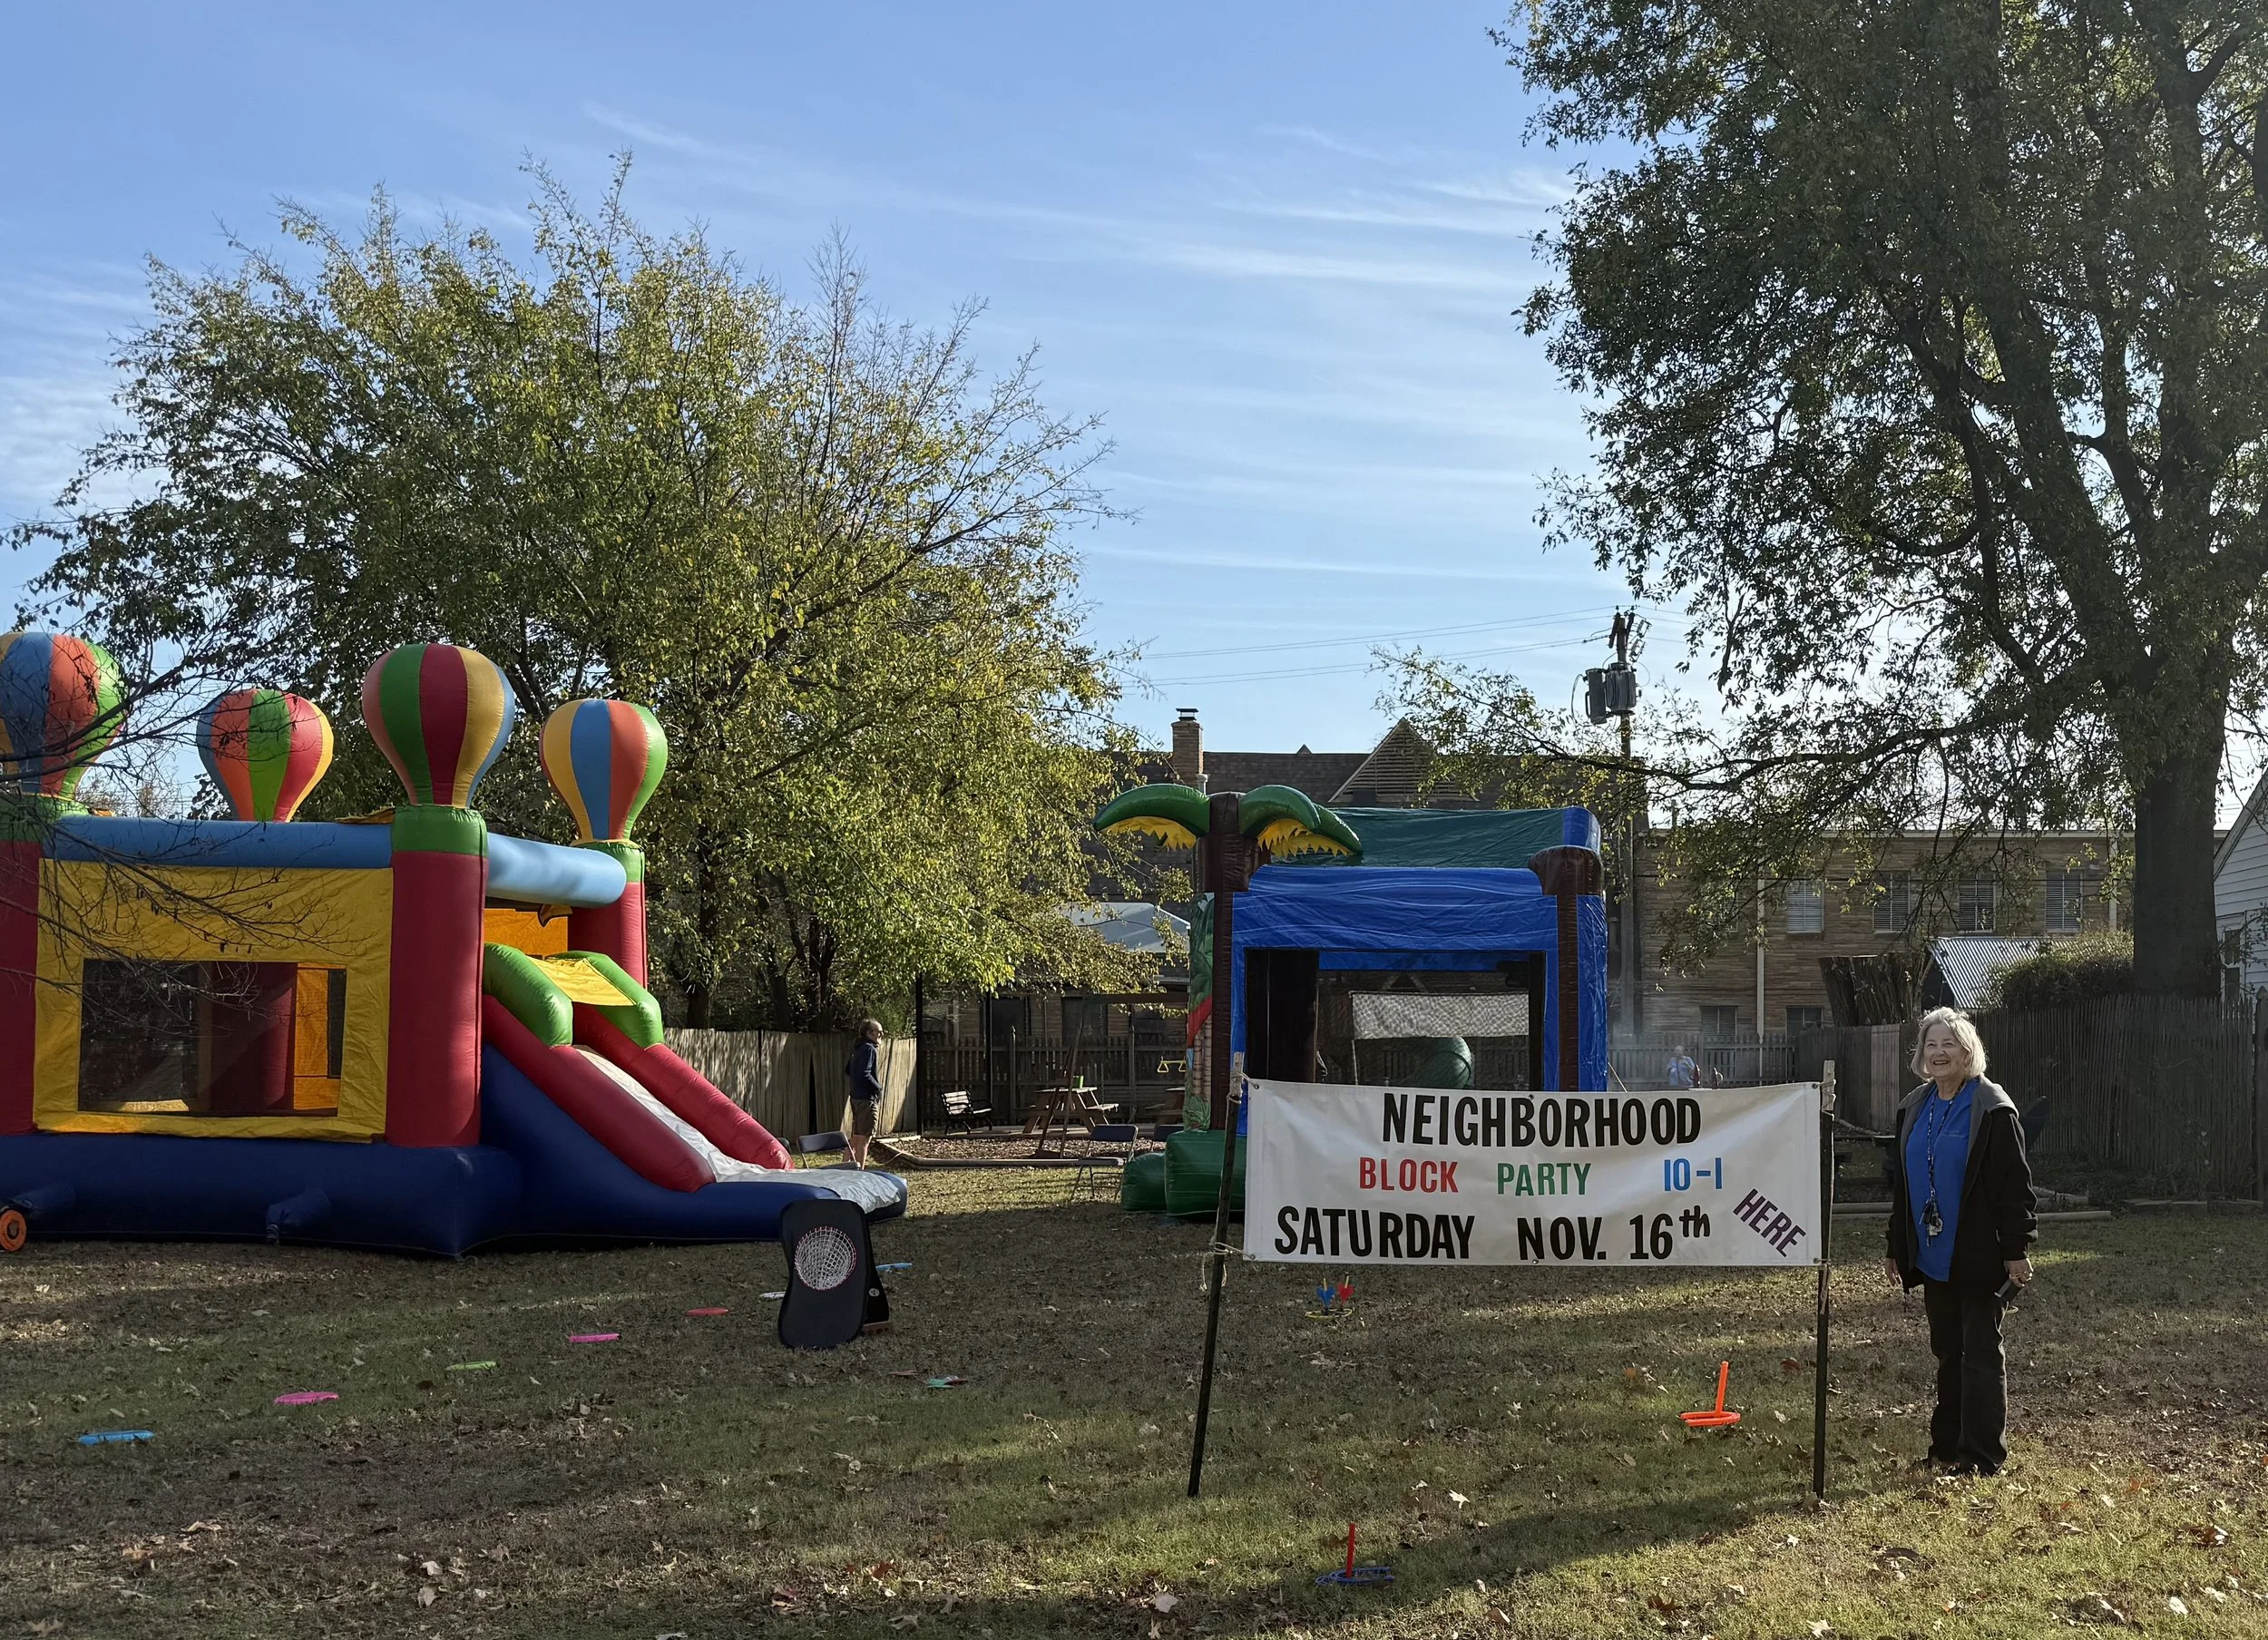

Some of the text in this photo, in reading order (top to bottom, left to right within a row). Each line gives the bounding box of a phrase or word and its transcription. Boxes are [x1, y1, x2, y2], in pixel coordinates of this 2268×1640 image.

[1383, 1093, 1701, 1147] NEIGHBORHOOD
[1359, 1157, 1723, 1196] BLOCK PARTY 10-1
[1275, 1205, 1711, 1261] SATURDAY NOV. 16th
[1732, 1188, 1807, 1257] HERE
